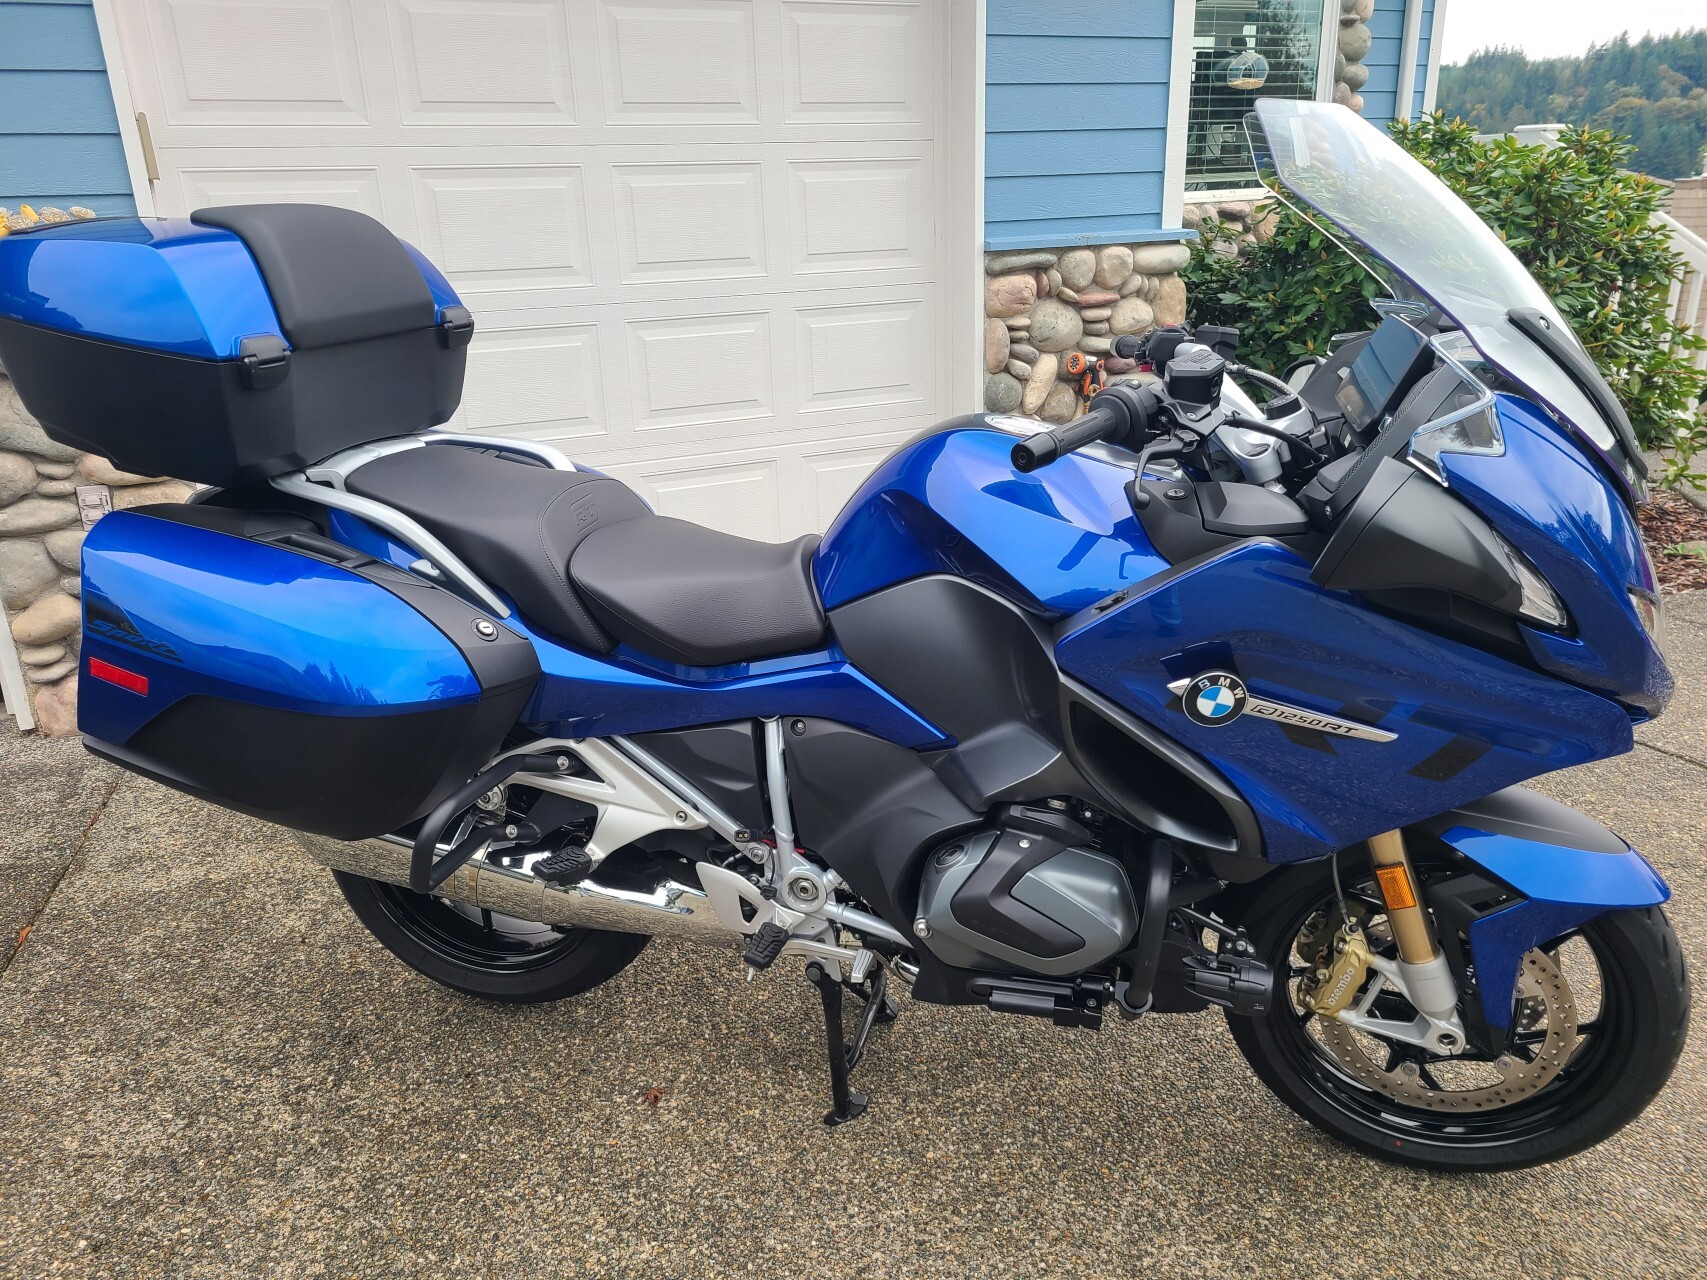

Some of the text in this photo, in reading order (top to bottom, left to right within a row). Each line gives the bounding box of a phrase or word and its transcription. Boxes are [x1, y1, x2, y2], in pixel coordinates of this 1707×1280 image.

[87, 619, 178, 656] Sport
[1198, 677, 1245, 699] BMW
[1325, 967, 1355, 1006] brembo
